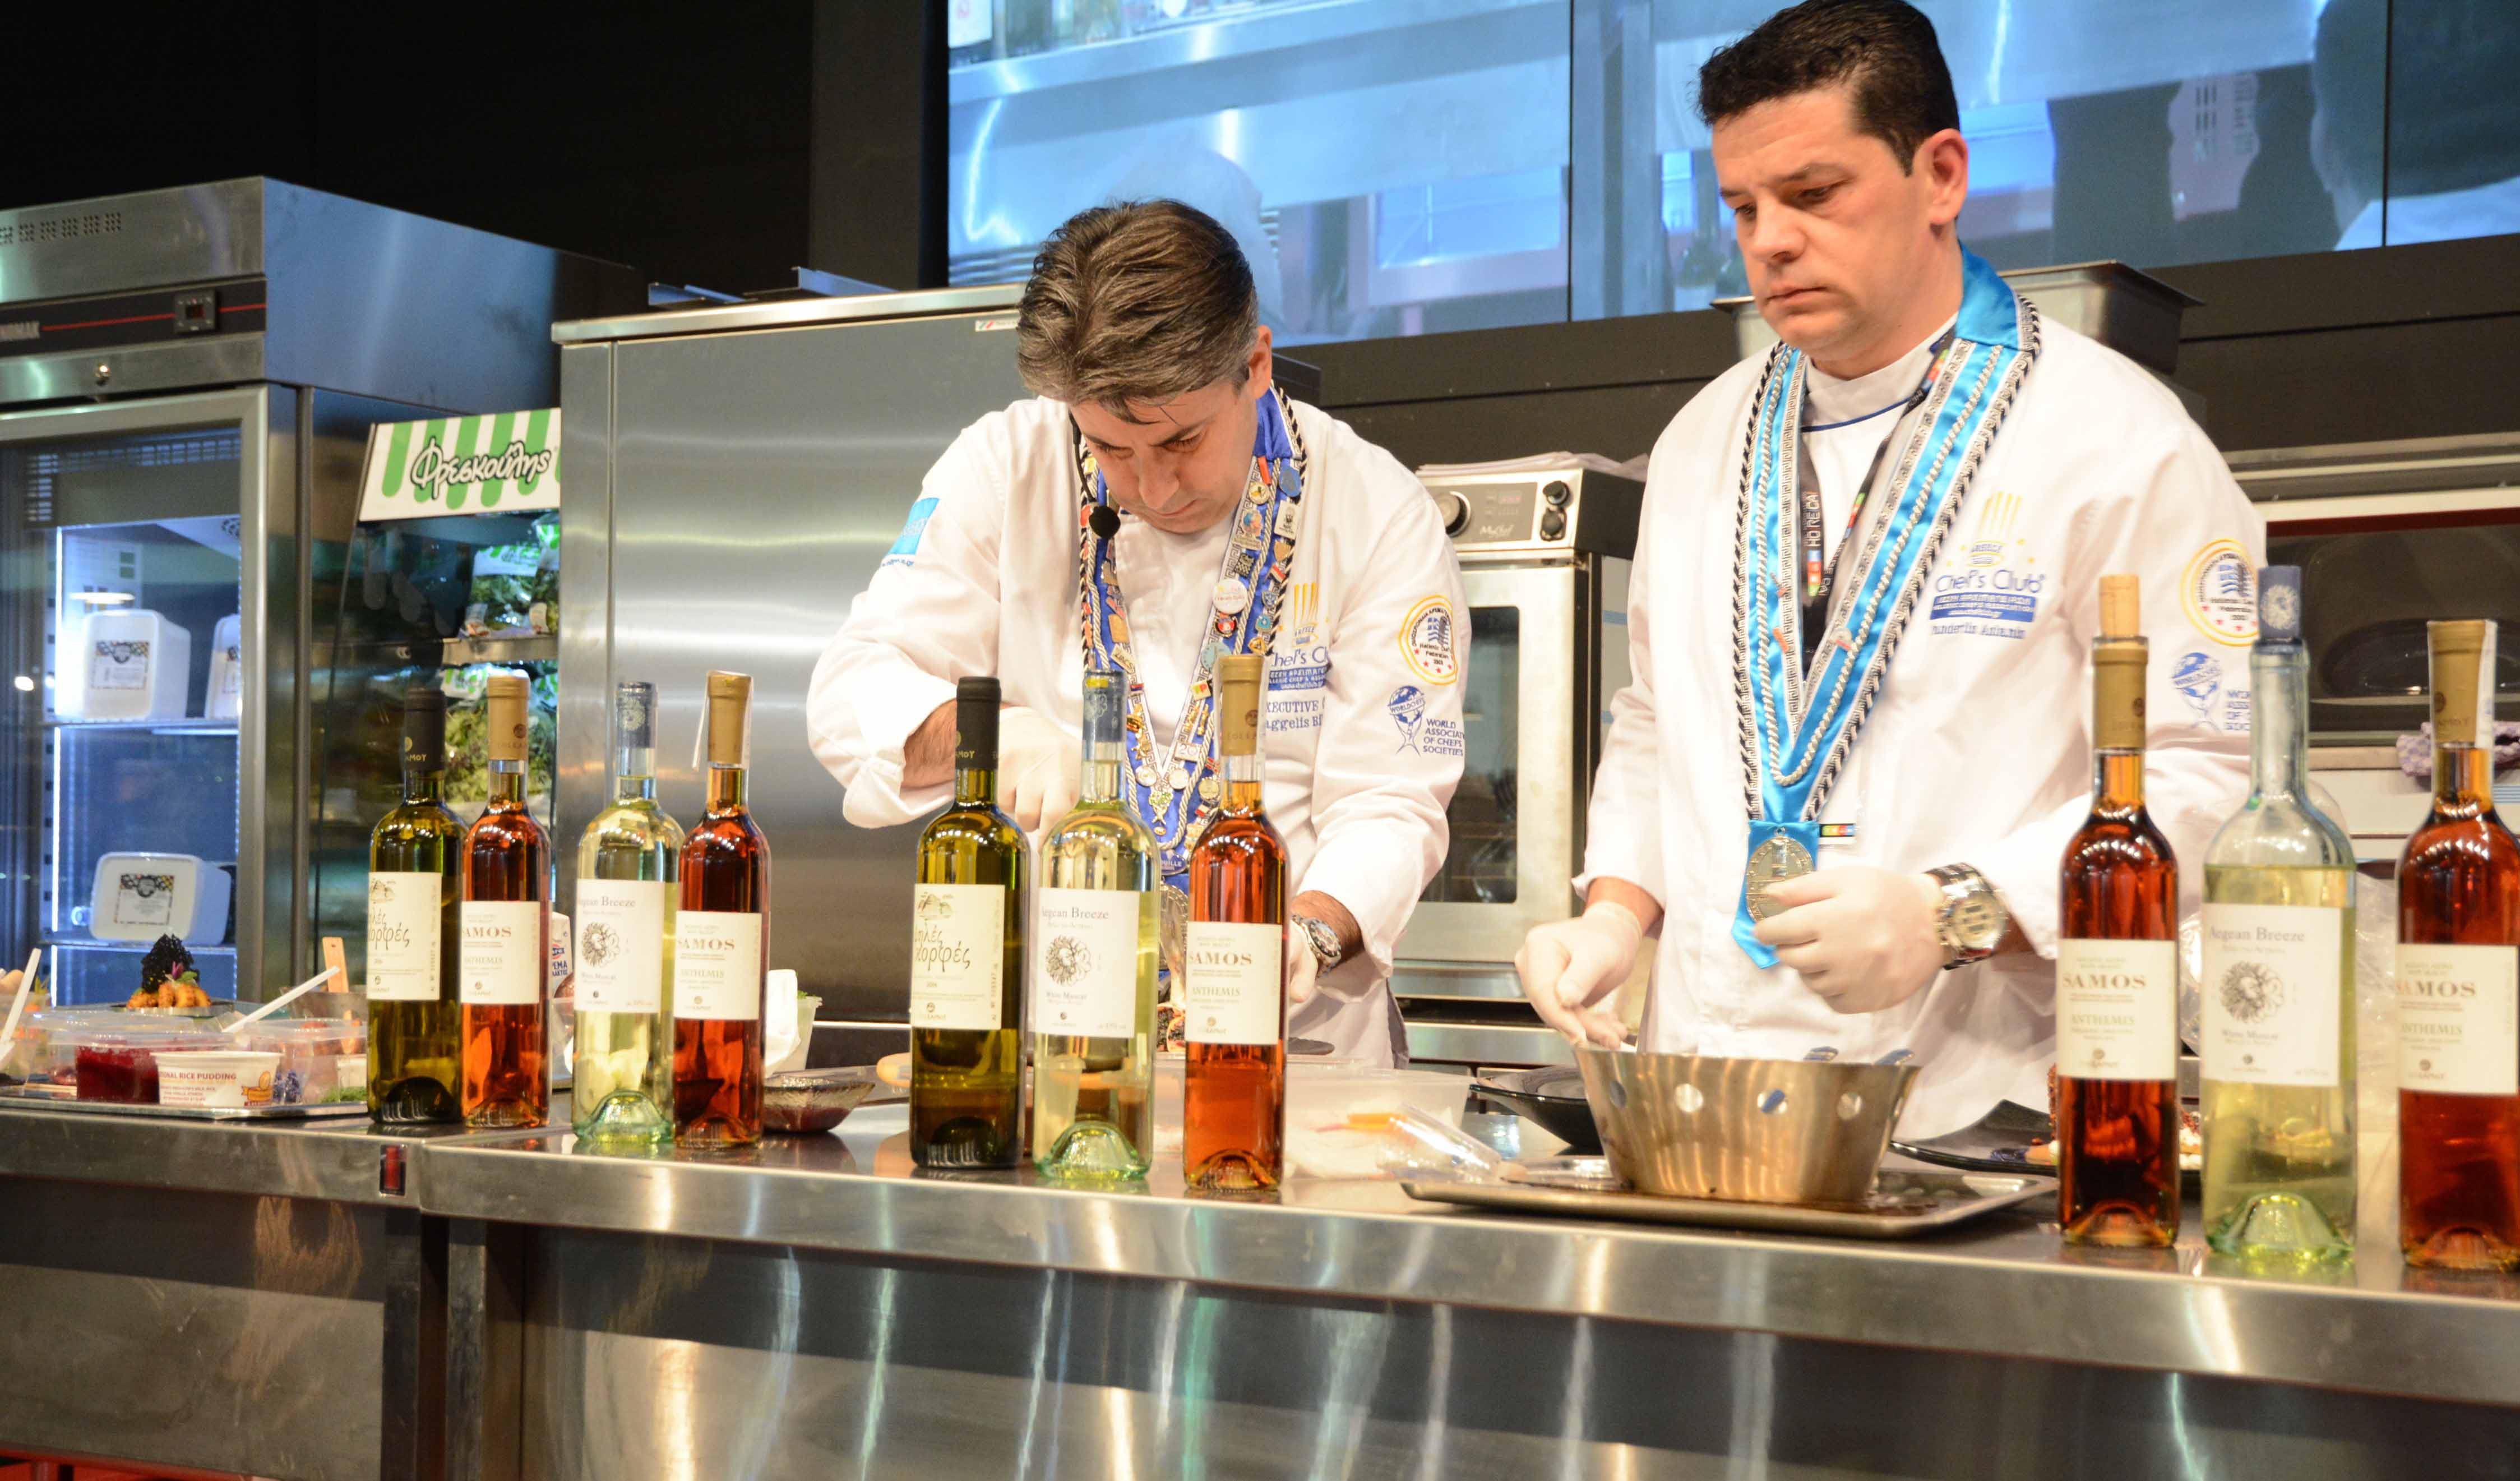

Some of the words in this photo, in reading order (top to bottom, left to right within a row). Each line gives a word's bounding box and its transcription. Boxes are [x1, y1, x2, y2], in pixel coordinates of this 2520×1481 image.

[411, 436, 551, 500] Φρεσκούλης
[1806, 493, 1821, 547] HORECA
[1271, 648, 1307, 667] hef's
[1312, 646, 1329, 664] Cl
[1266, 700, 1319, 713] XECUTIVE
[1265, 717, 1310, 732] aggelis
[1427, 718, 1456, 728] WORLD
[1426, 728, 1465, 740] ASSOCIAT
[1437, 737, 1462, 747] CHEFS
[1423, 745, 1463, 756] SOCIETIES
[601, 896, 636, 907] Breeze
[1071, 906, 1109, 919] Breeze
[369, 922, 410, 951] ορφές
[463, 926, 512, 938] AMOS
[2256, 926, 2305, 942] Breeze
[1189, 952, 1252, 966] SAMOS
[2062, 974, 2147, 990] SAMOS
